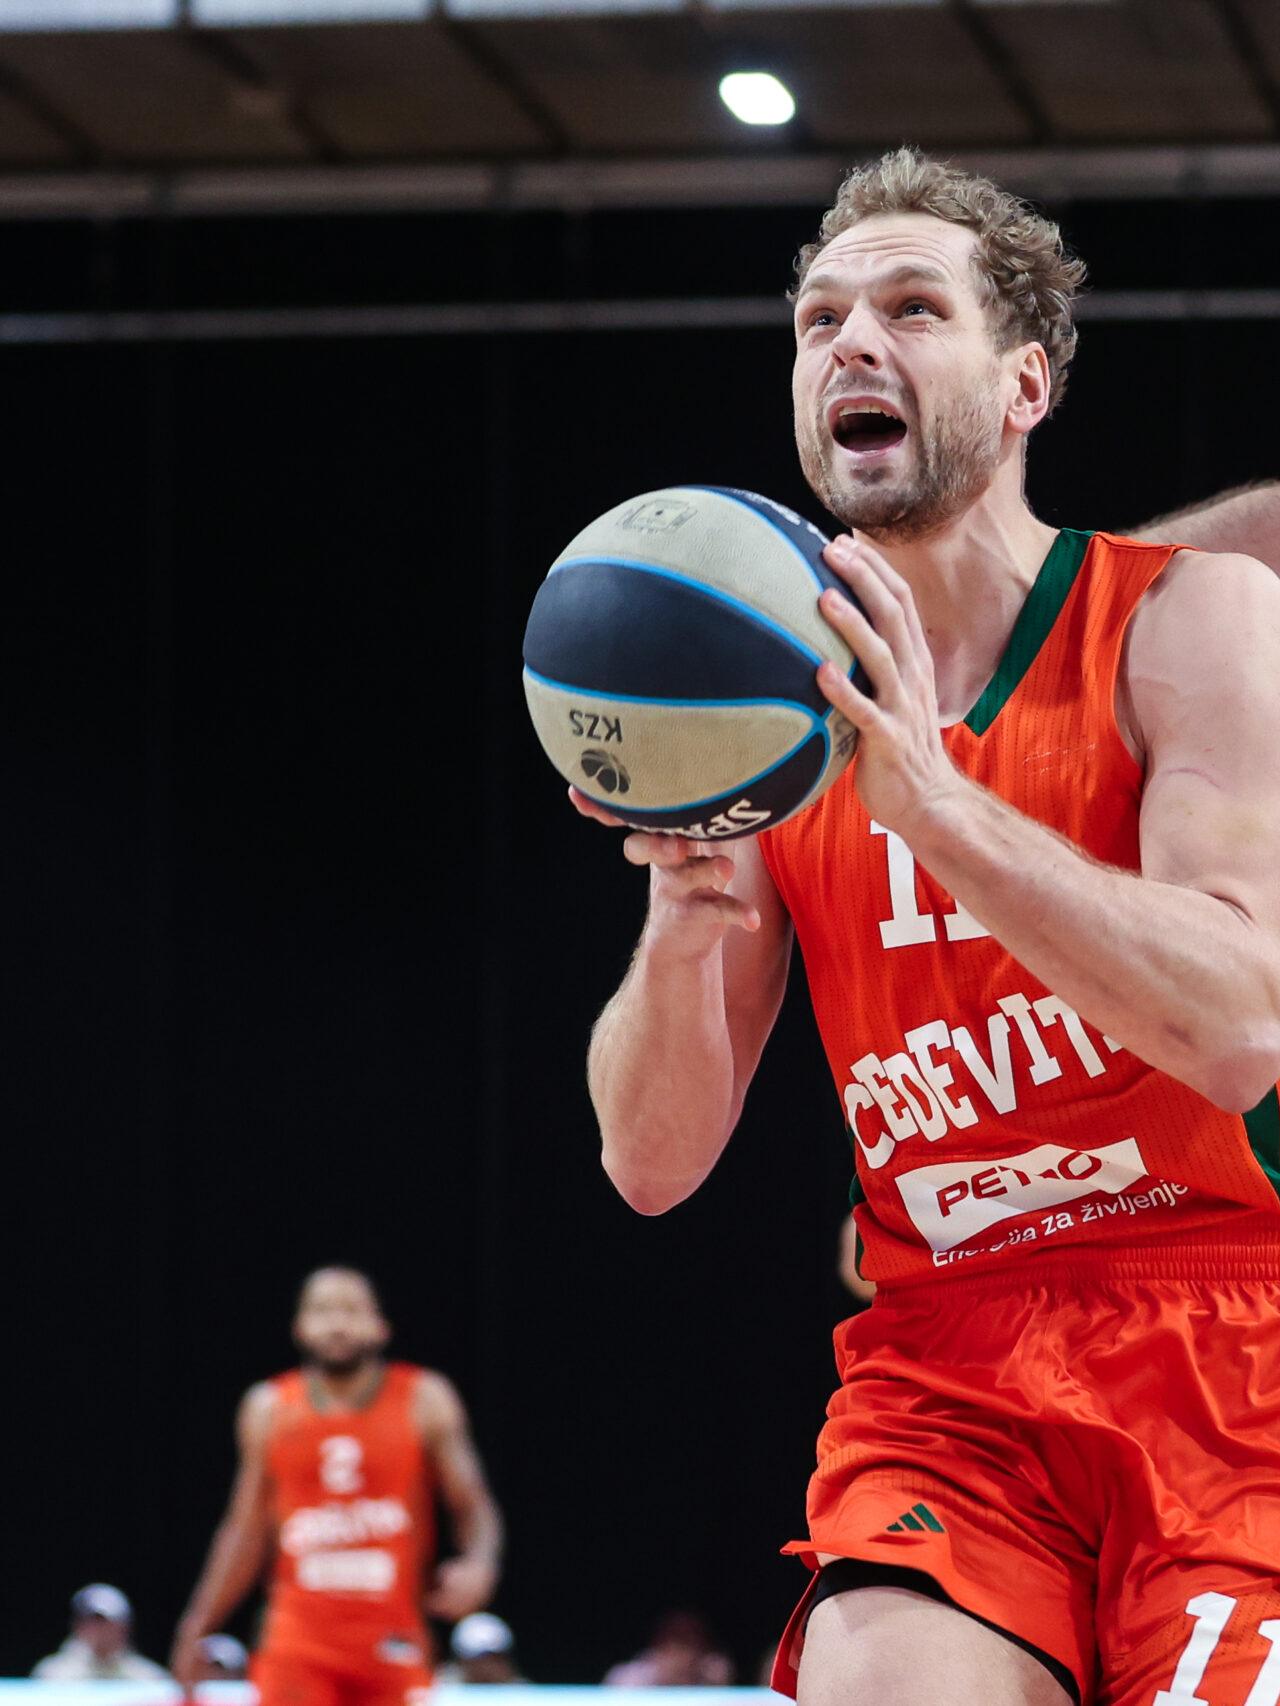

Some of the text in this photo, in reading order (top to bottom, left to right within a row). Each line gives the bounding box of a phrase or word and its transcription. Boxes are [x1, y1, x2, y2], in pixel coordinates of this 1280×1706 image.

[569, 709, 623, 743] KZS
[843, 992, 1124, 1171] CEDEVIT
[1041, 1211, 1074, 1236] za
